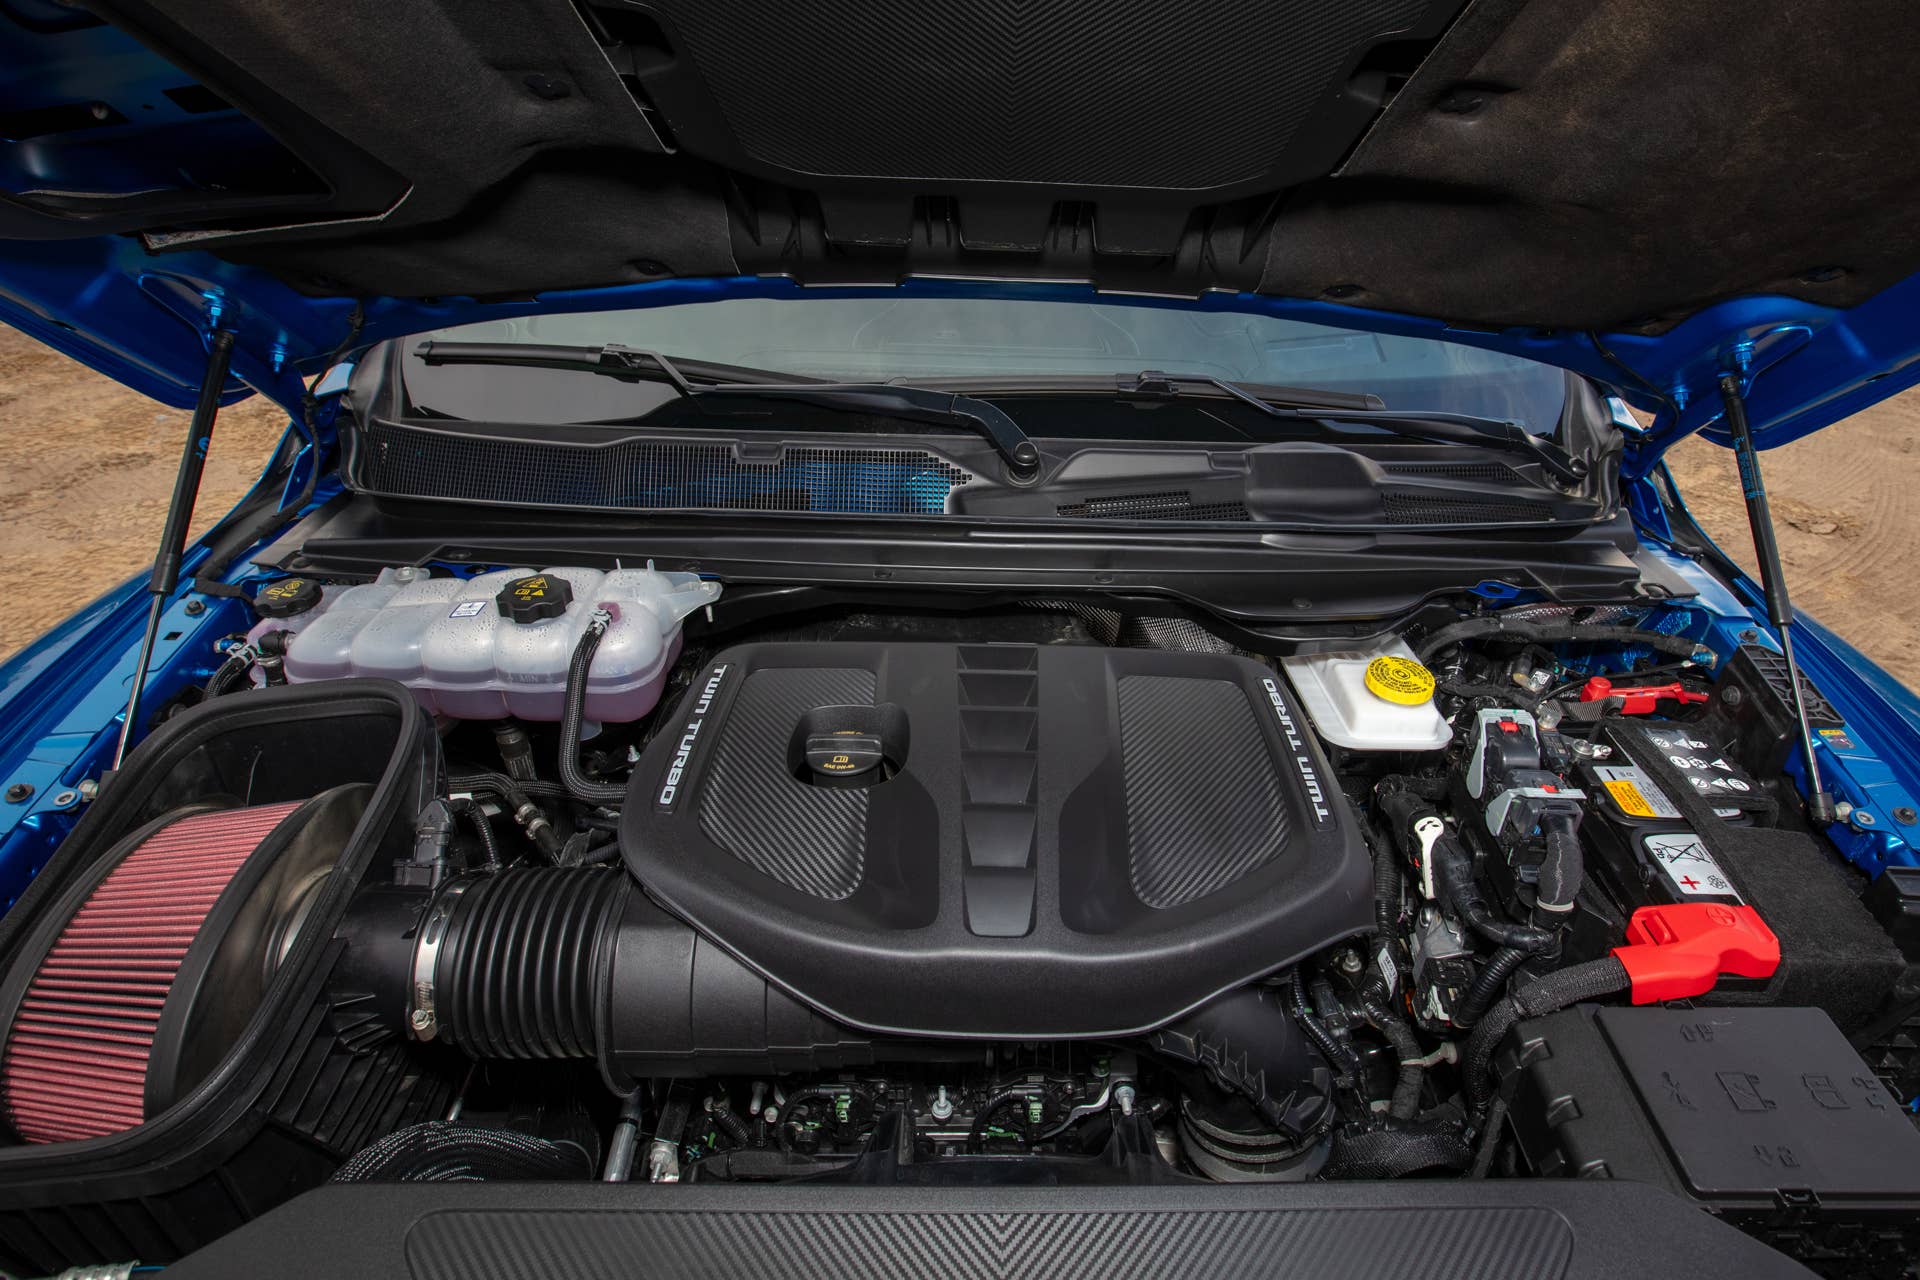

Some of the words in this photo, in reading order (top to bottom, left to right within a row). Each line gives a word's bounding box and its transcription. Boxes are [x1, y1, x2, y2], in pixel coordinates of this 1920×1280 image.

[695, 664, 727, 713] TWIN
[1263, 679, 1301, 751] TURBO
[660, 720, 702, 805] TURBO
[1297, 757, 1328, 822] TWIN
[1652, 848, 1665, 858] Pb
